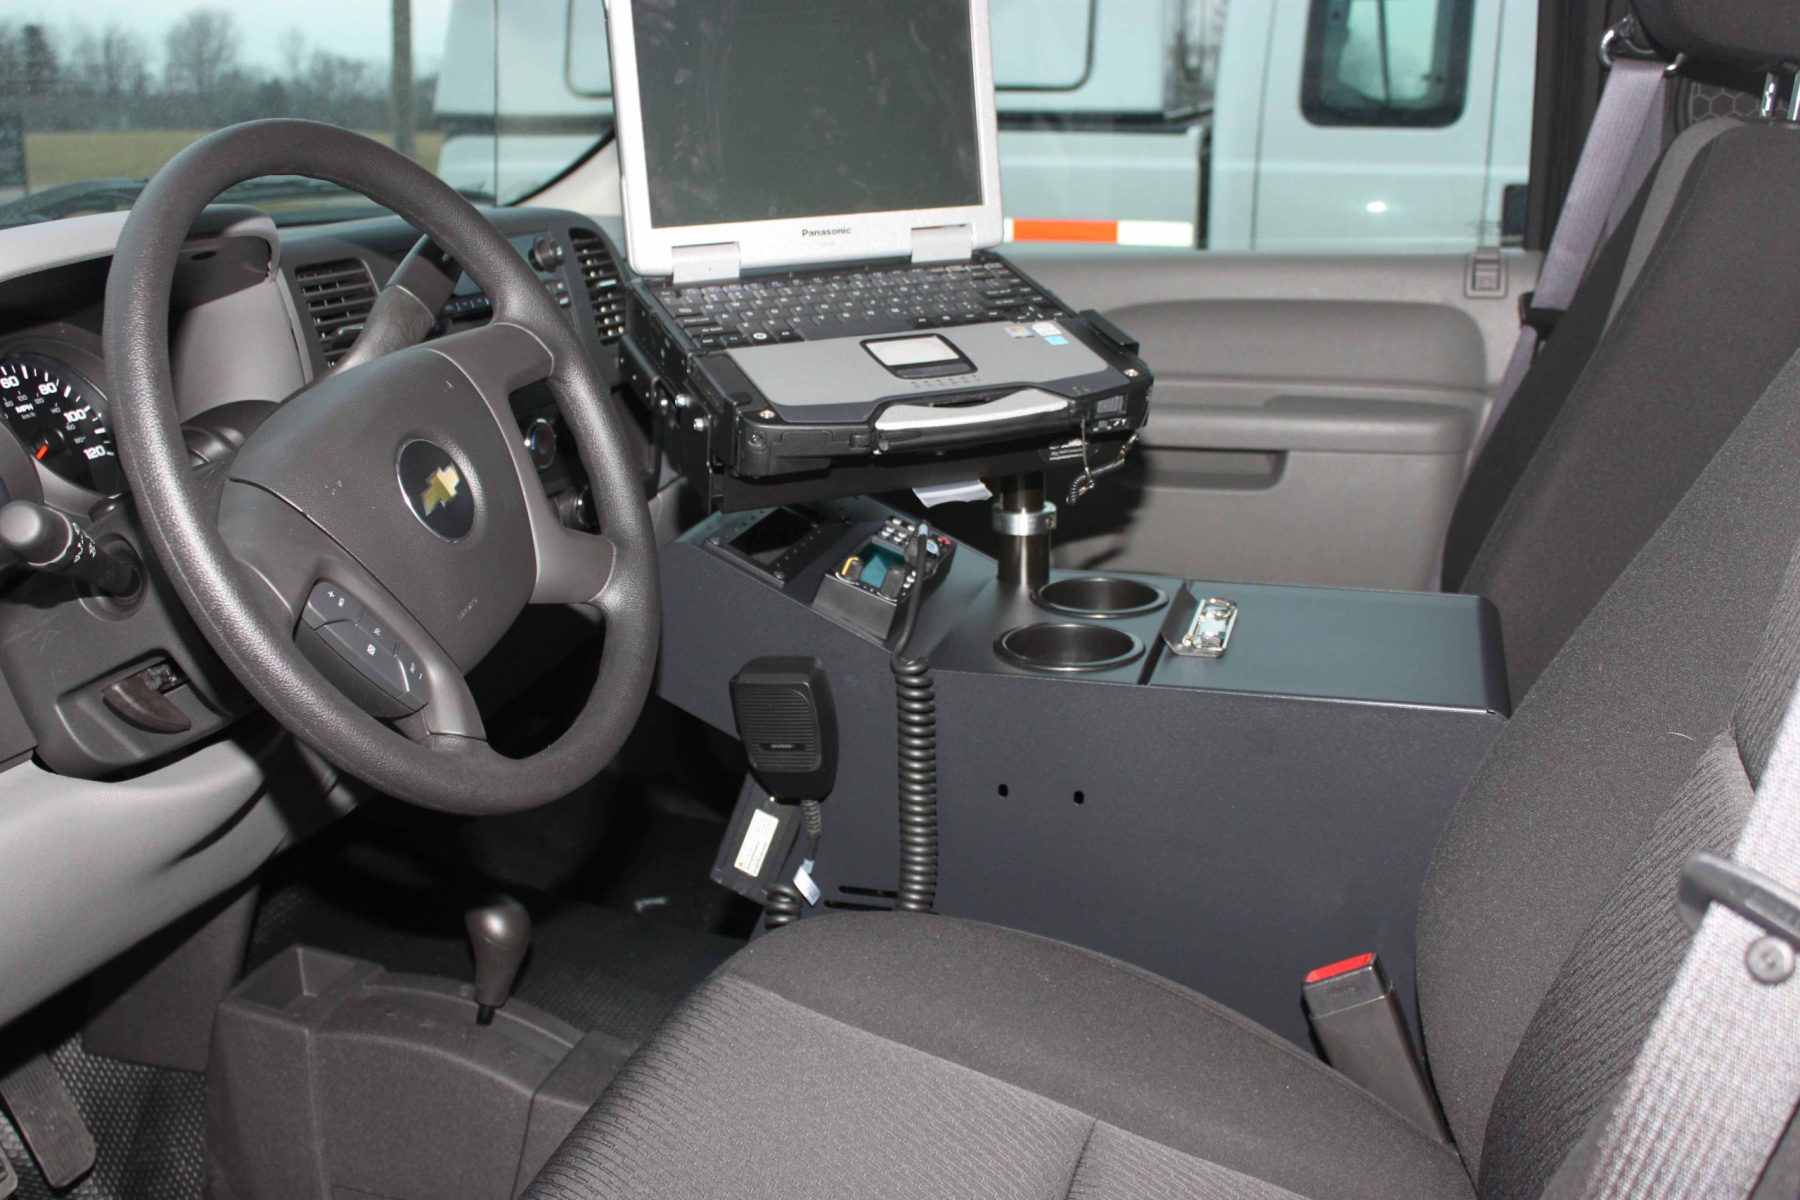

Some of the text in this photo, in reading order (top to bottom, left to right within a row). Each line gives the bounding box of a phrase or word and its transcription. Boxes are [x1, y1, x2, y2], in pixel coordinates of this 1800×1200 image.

[801, 226, 852, 237] Panasonic
[0, 375, 20, 389] 60
[38, 382, 58, 395] 80
[15, 403, 34, 414] MPH
[63, 409, 87, 423] 100
[83, 445, 106, 460] 120
